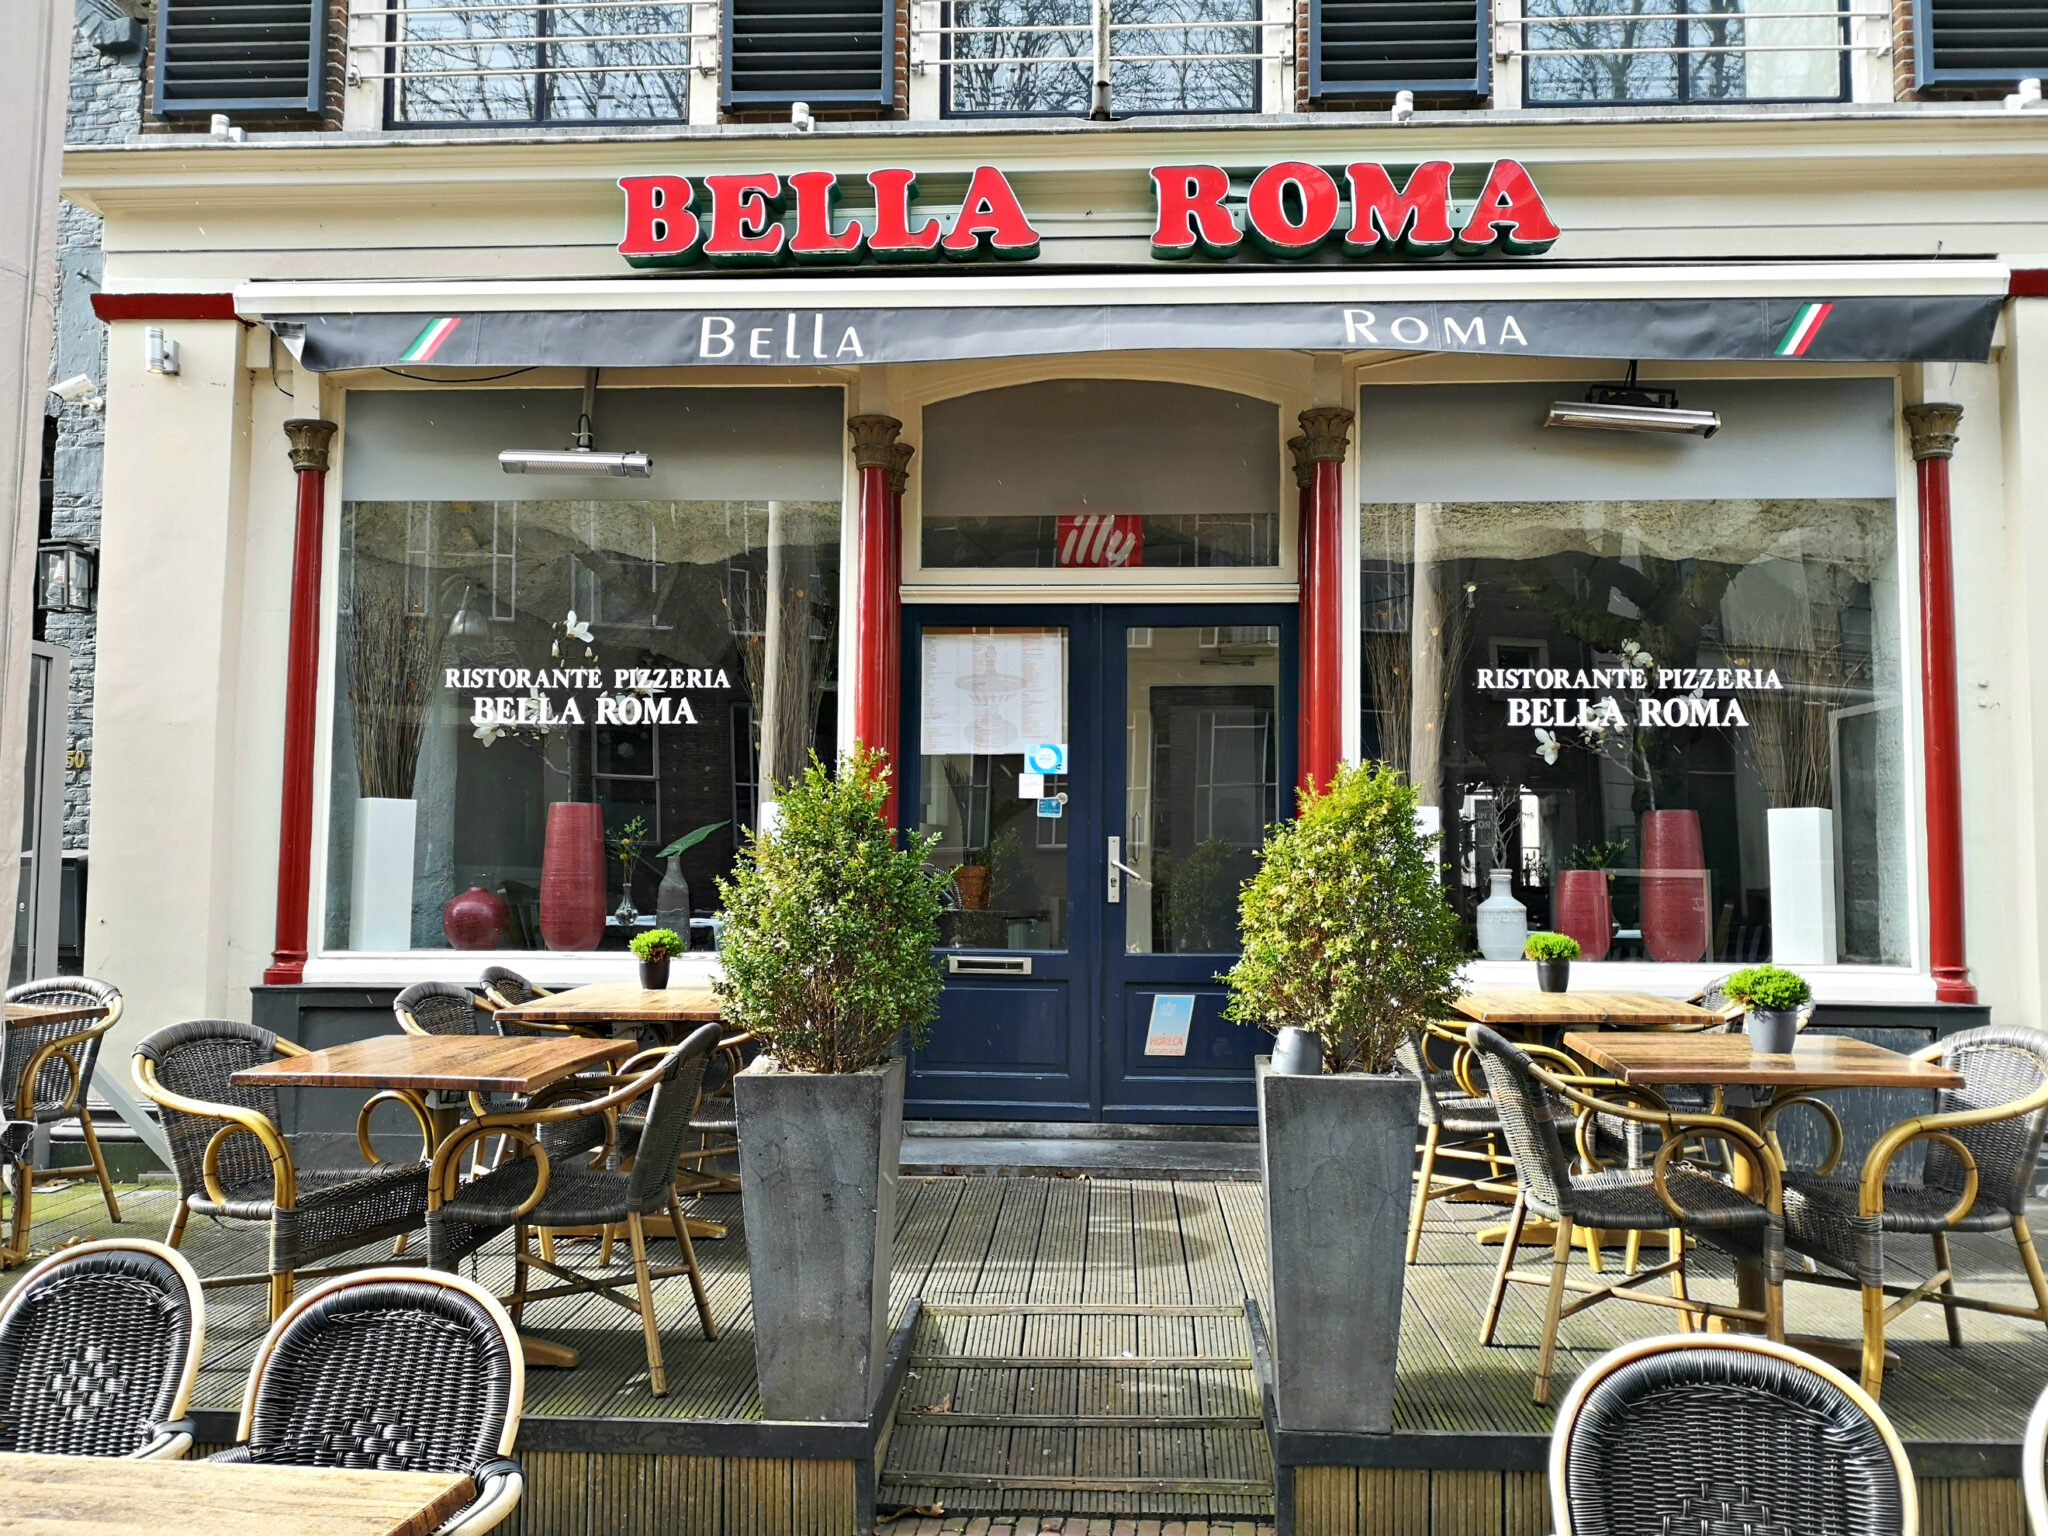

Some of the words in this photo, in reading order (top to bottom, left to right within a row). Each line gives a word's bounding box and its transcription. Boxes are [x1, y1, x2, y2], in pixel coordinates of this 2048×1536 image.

[617, 165, 1041, 268] BELLA
[1150, 158, 1562, 260] ROMA
[1061, 514, 1136, 568] illy
[444, 668, 603, 689] RISTORANTE
[613, 668, 731, 689] PIZZERIA
[1477, 668, 1648, 690] RISTORANTE
[1658, 668, 1784, 690] PIZZERIA
[472, 696, 584, 725] BELLA
[595, 696, 698, 725] ROMA
[1507, 697, 1628, 727] BELLA
[1639, 697, 1749, 727] ROMA
[65, 750, 86, 769] 50
[1150, 1036, 1183, 1046] HORECA
